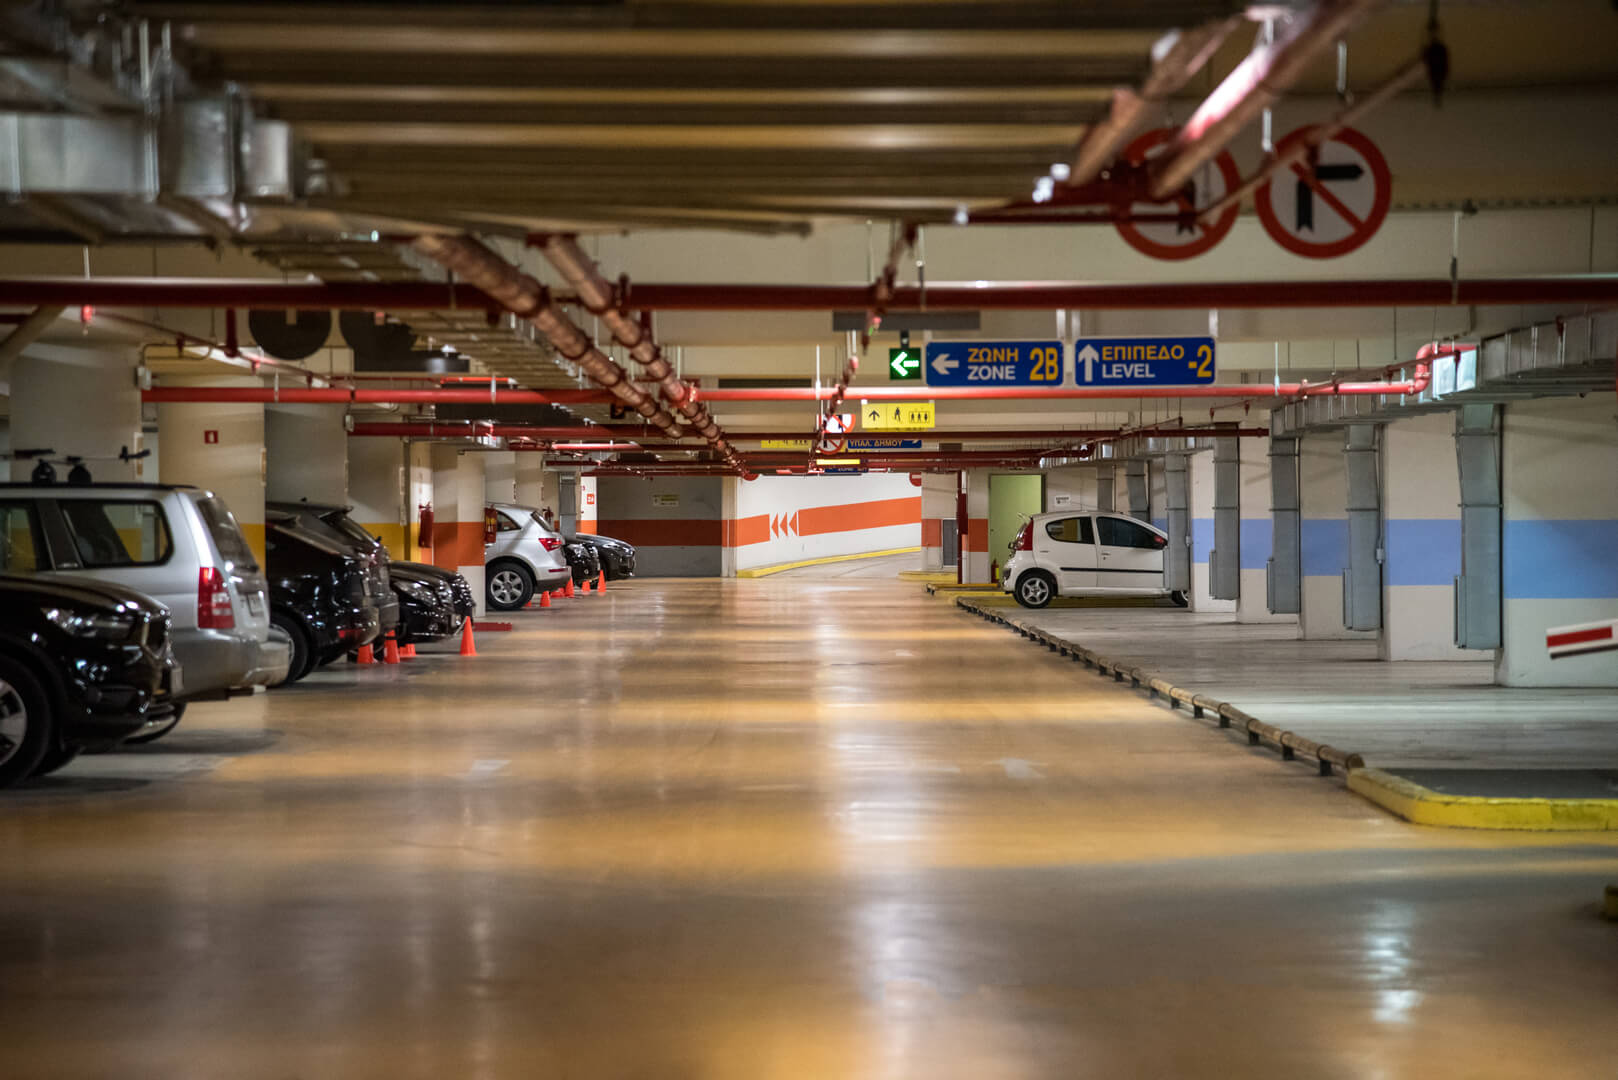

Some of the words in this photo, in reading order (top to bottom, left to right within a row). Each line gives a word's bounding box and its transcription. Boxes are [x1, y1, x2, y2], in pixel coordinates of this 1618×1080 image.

[967, 347, 1019, 362] ΖΩΝΗ
[1102, 345, 1185, 361] ΕΠΙΠΕΔΟ
[1029, 347, 1059, 381] 2B
[1188, 344, 1213, 378] -2
[967, 365, 1016, 380] ZONE
[1102, 363, 1156, 378] LEVEL
